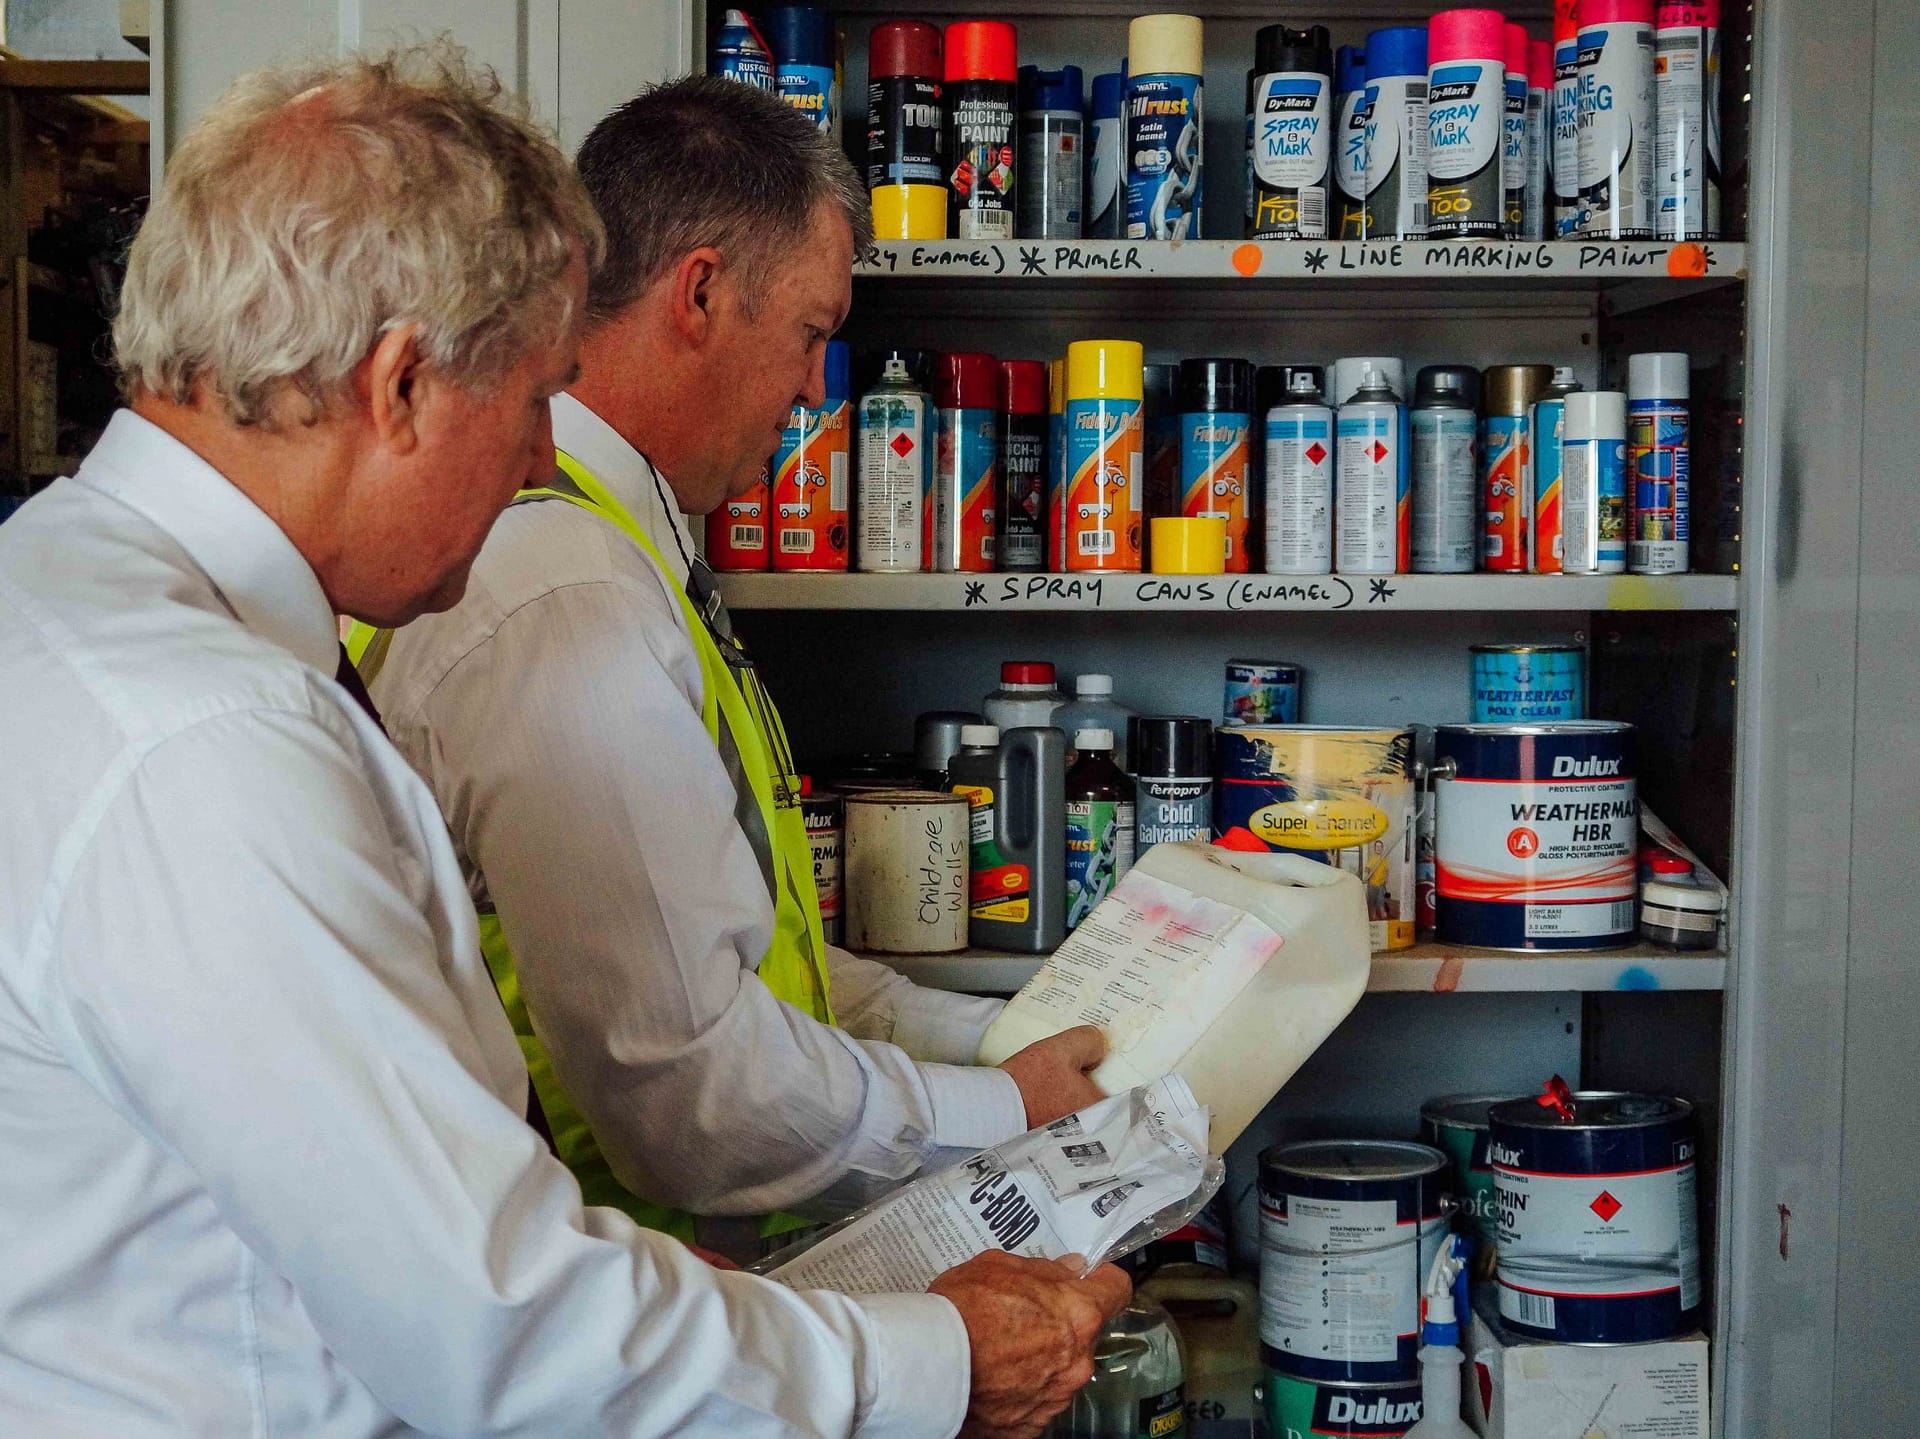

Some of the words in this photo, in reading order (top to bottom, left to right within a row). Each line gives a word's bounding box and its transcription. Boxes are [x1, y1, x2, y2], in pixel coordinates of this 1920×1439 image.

[1136, 82, 1169, 92] WATTYL
[1430, 85, 1470, 100] Dy-Mark
[959, 100, 1009, 110] Professional
[1268, 98, 1313, 109] Dy-Mark
[1556, 87, 1577, 109] LIN
[1578, 85, 1612, 112] KING
[953, 111, 1014, 126] TOUCH-UP
[1428, 104, 1480, 128] SPRAY
[960, 125, 1010, 143] PAINT
[1140, 123, 1163, 133] Satin
[1261, 117, 1320, 140] SPRAY
[1136, 131, 1167, 142] Enamel
[1268, 137, 1313, 157] MARK
[1158, 153, 1167, 164] 3
[984, 199, 1002, 209] Jobs
[1459, 221, 1497, 231] MARKING
[1007, 457, 1041, 473] AINT
[1000, 577, 1103, 606] SPRAY
[1136, 580, 1215, 603] CANS
[1477, 688, 1576, 702] WEATHERFAST
[1488, 706, 1516, 716] POLY
[1520, 706, 1561, 717] CLEAR
[1552, 755, 1620, 777] Dulux
[1150, 783, 1201, 797] ferropro
[1548, 785, 1596, 793] PROTECTIVE
[1158, 803, 1194, 824] Cold
[1263, 813, 1308, 832] Super
[1316, 813, 1377, 830] Enamel
[1572, 823, 1612, 842] HBR
[1538, 852, 1564, 860] GLOSS
[1549, 844, 1570, 853] HIGH
[1571, 844, 1592, 852] BUILD
[919, 816, 943, 925] Childcare
[944, 840, 964, 912] Walls
[1328, 1395, 1422, 1425] Dulux
